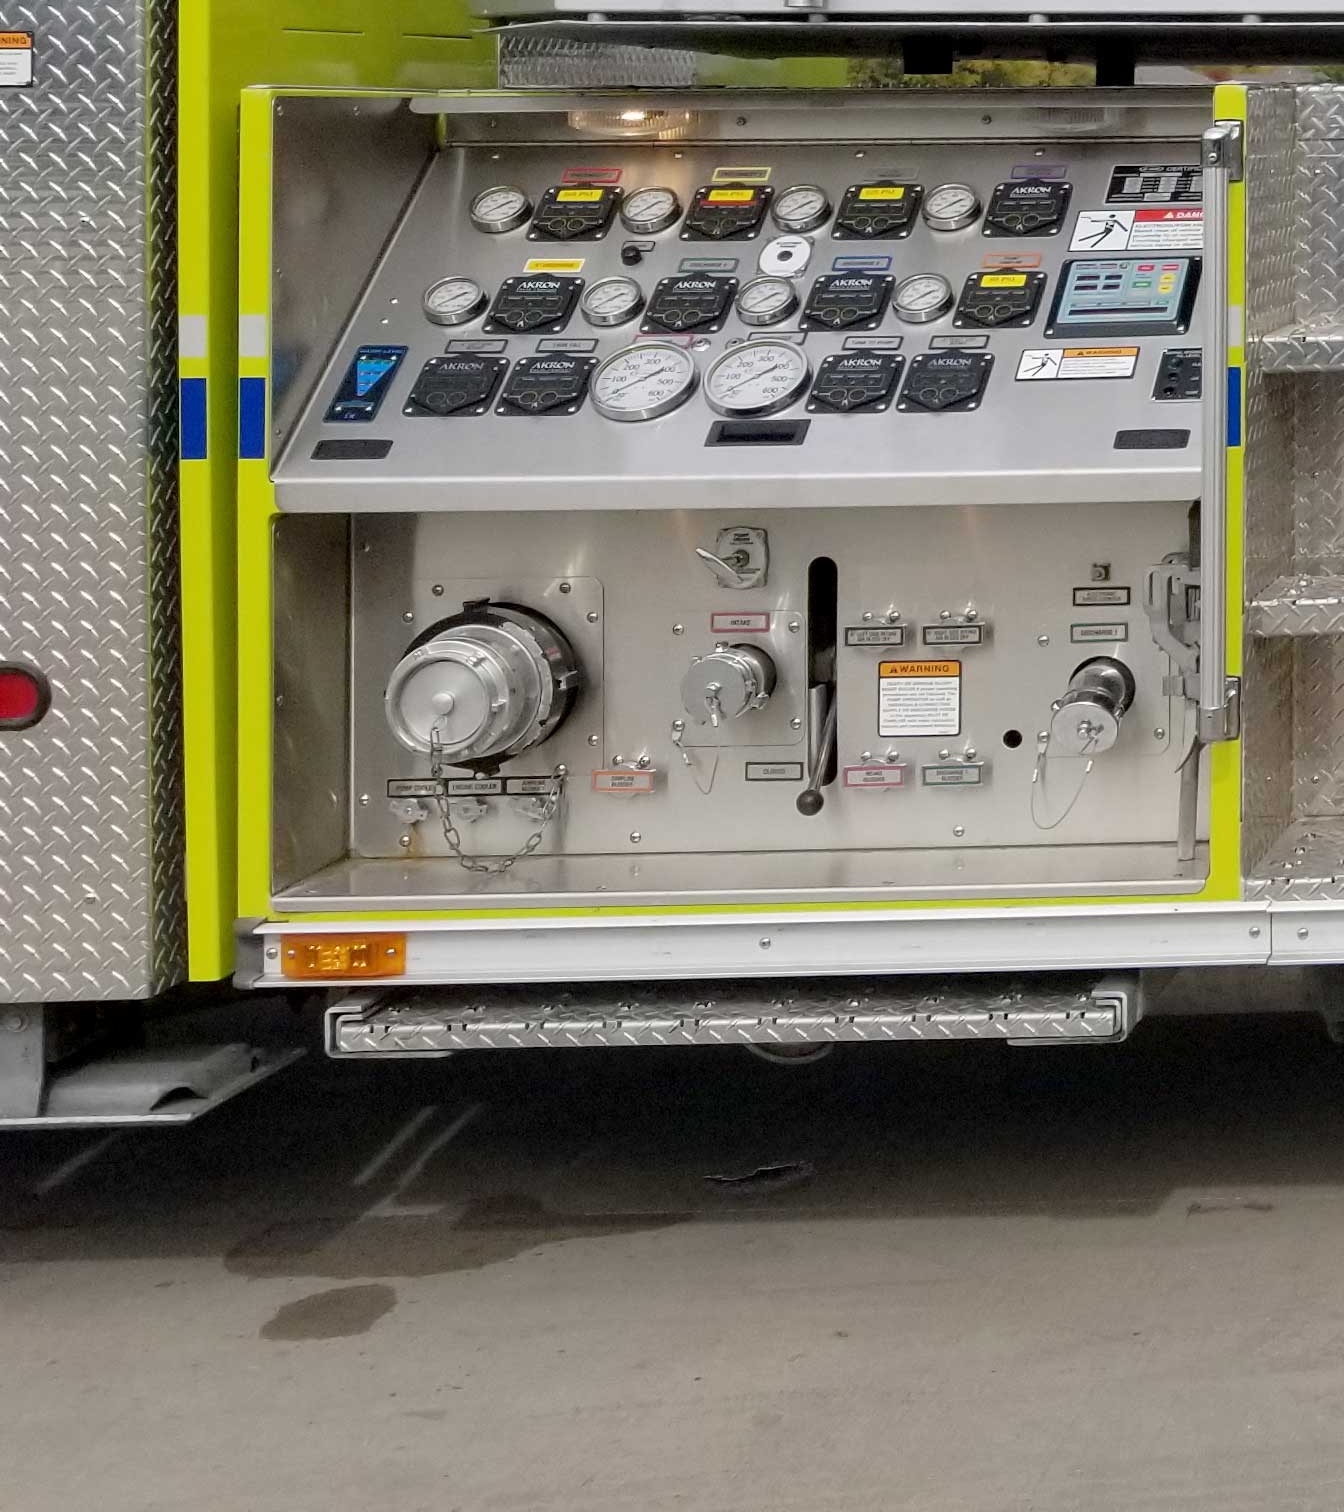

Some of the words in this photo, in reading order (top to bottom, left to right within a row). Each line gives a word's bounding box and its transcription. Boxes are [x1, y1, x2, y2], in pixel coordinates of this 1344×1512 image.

[0, 37, 27, 45] NING
[1011, 186, 1052, 194] AKRON
[518, 281, 561, 289] AKRON
[673, 281, 717, 289] AKRON
[830, 278, 873, 286] AKRON
[440, 362, 485, 370] AKRON
[531, 361, 576, 370] AKRON
[839, 358, 882, 366] AKRON
[930, 358, 972, 366] AKRON
[899, 664, 950, 673] WARNING
